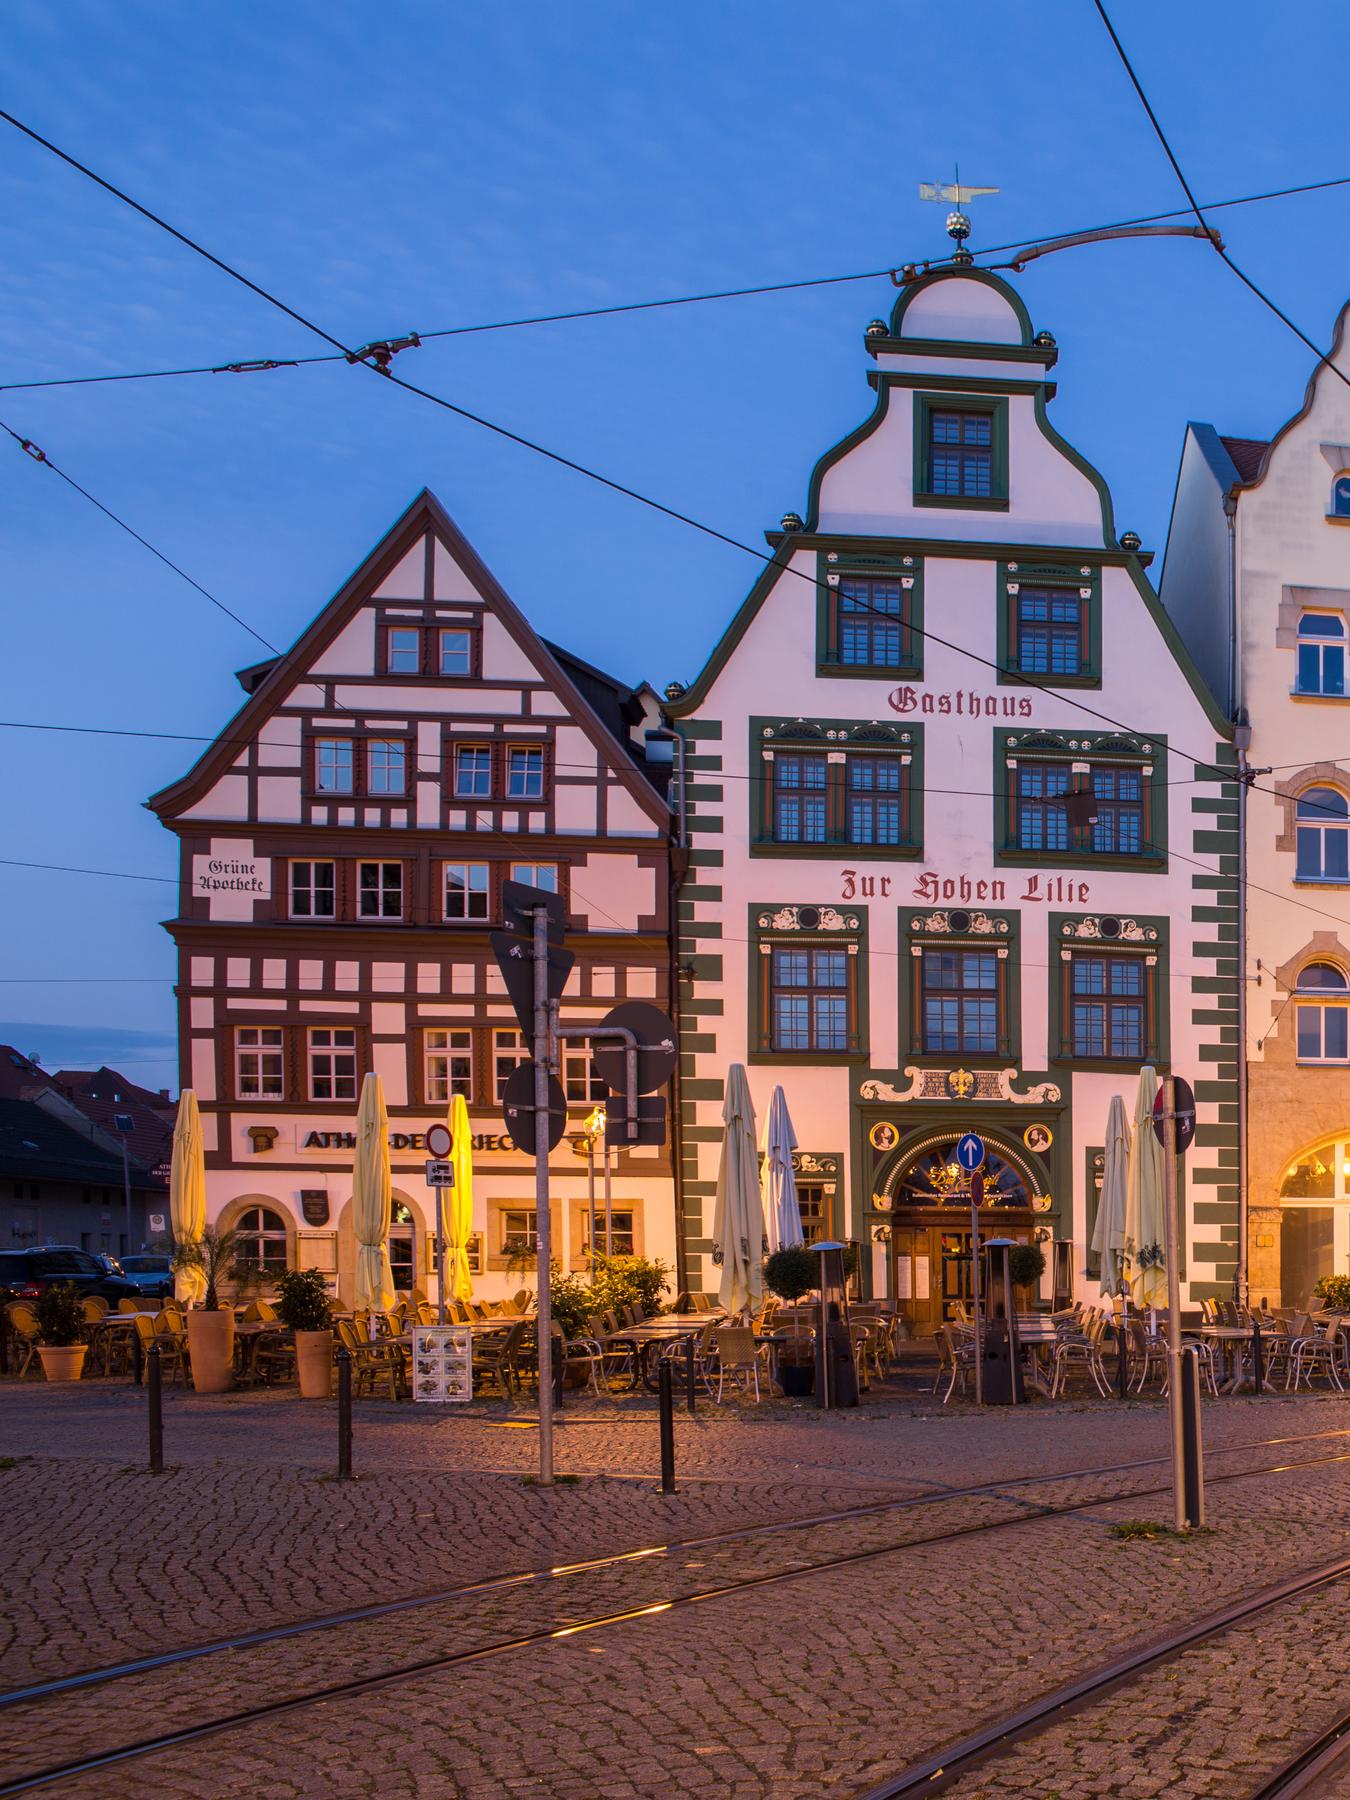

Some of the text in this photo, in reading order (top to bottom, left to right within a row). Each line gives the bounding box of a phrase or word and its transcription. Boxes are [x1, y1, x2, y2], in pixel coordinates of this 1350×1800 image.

[888, 686, 1032, 719] Gasthaus
[208, 860, 256, 875] Grüne
[200, 876, 264, 891] Apotheke
[841, 870, 1090, 904] Zur Hohen Lilie
